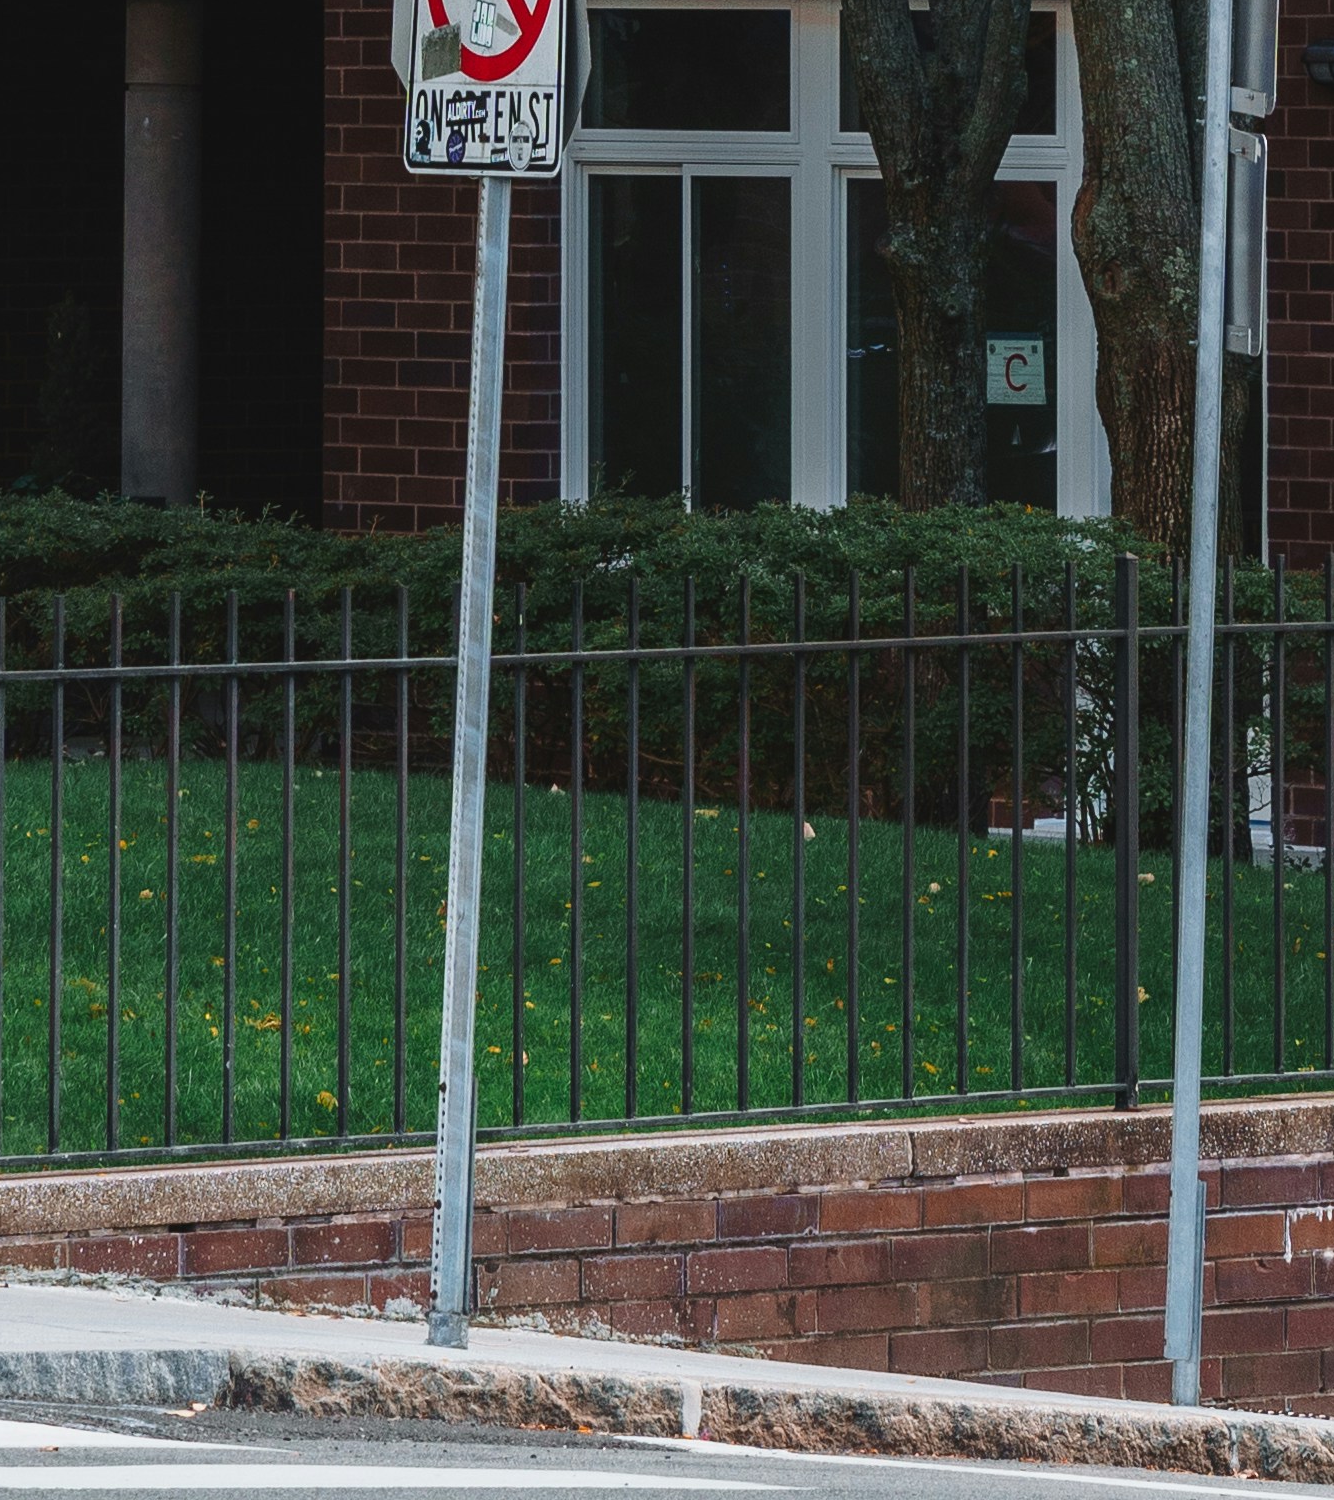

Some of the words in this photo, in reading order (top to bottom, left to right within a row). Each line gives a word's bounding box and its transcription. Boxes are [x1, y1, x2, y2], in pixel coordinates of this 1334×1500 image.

[416, 89, 444, 143] ON
[529, 91, 554, 146] ST
[1005, 353, 1028, 392] C
